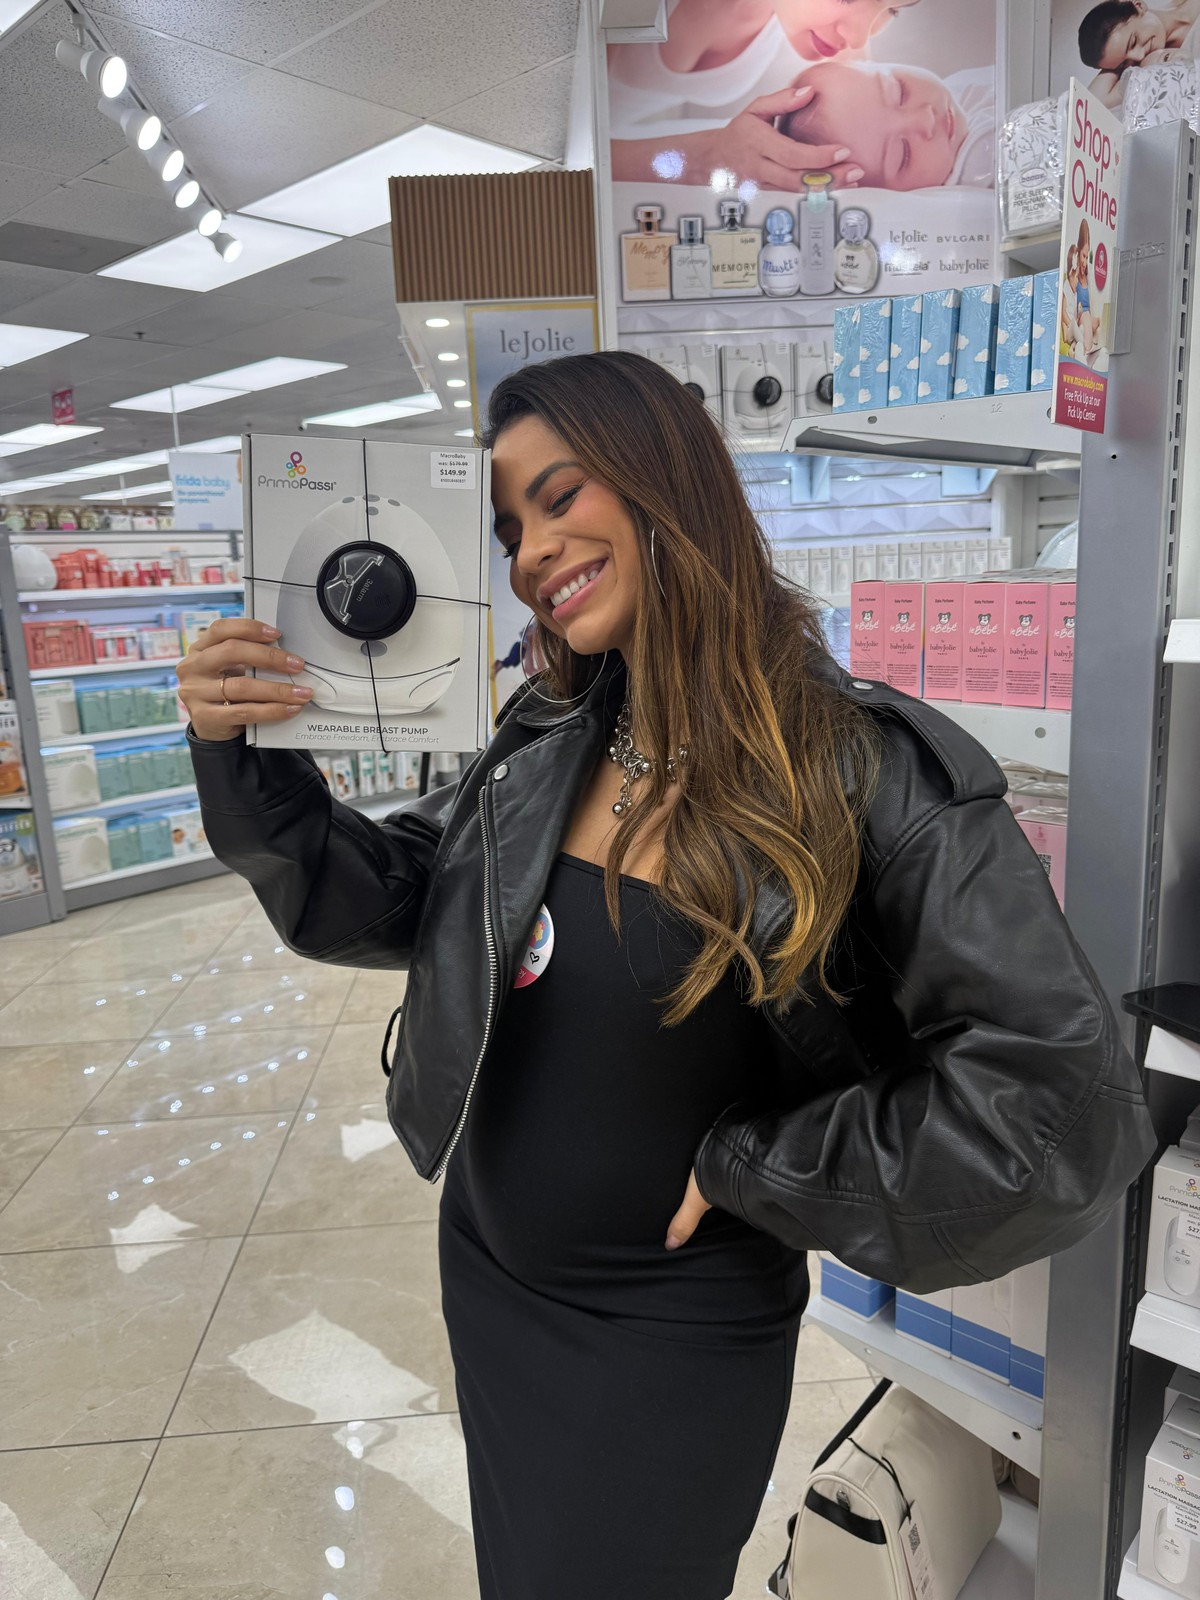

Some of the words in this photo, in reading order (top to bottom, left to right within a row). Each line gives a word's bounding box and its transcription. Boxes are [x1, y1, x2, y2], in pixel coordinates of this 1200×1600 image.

[1074, 98, 1111, 182] Shop
[1072, 159, 1117, 230] Online
[936, 234, 990, 243] BVLGARI
[712, 262, 757, 272] MEMORY
[500, 328, 575, 360] leJolie
[1064, 388, 1073, 402] Free
[1074, 390, 1082, 403] Pick
[1083, 392, 1089, 407] Up
[1089, 396, 1094, 406] at
[1067, 405, 1076, 418] Pick
[1077, 407, 1082, 423] Up
[1083, 408, 1096, 422] Center
[307, 724, 361, 733] WEARABLE
[363, 726, 399, 734] BREAST
[401, 727, 429, 735] PUMP
[295, 732, 331, 740] Embrace
[333, 733, 369, 742] Freedom,
[372, 734, 406, 743] Embrace
[408, 735, 439, 744] Comfort
[1158, 1195, 1188, 1208] LACTATION
[1147, 1484, 1178, 1501] LACTATION
[1176, 1517, 1197, 1530] $27.99
